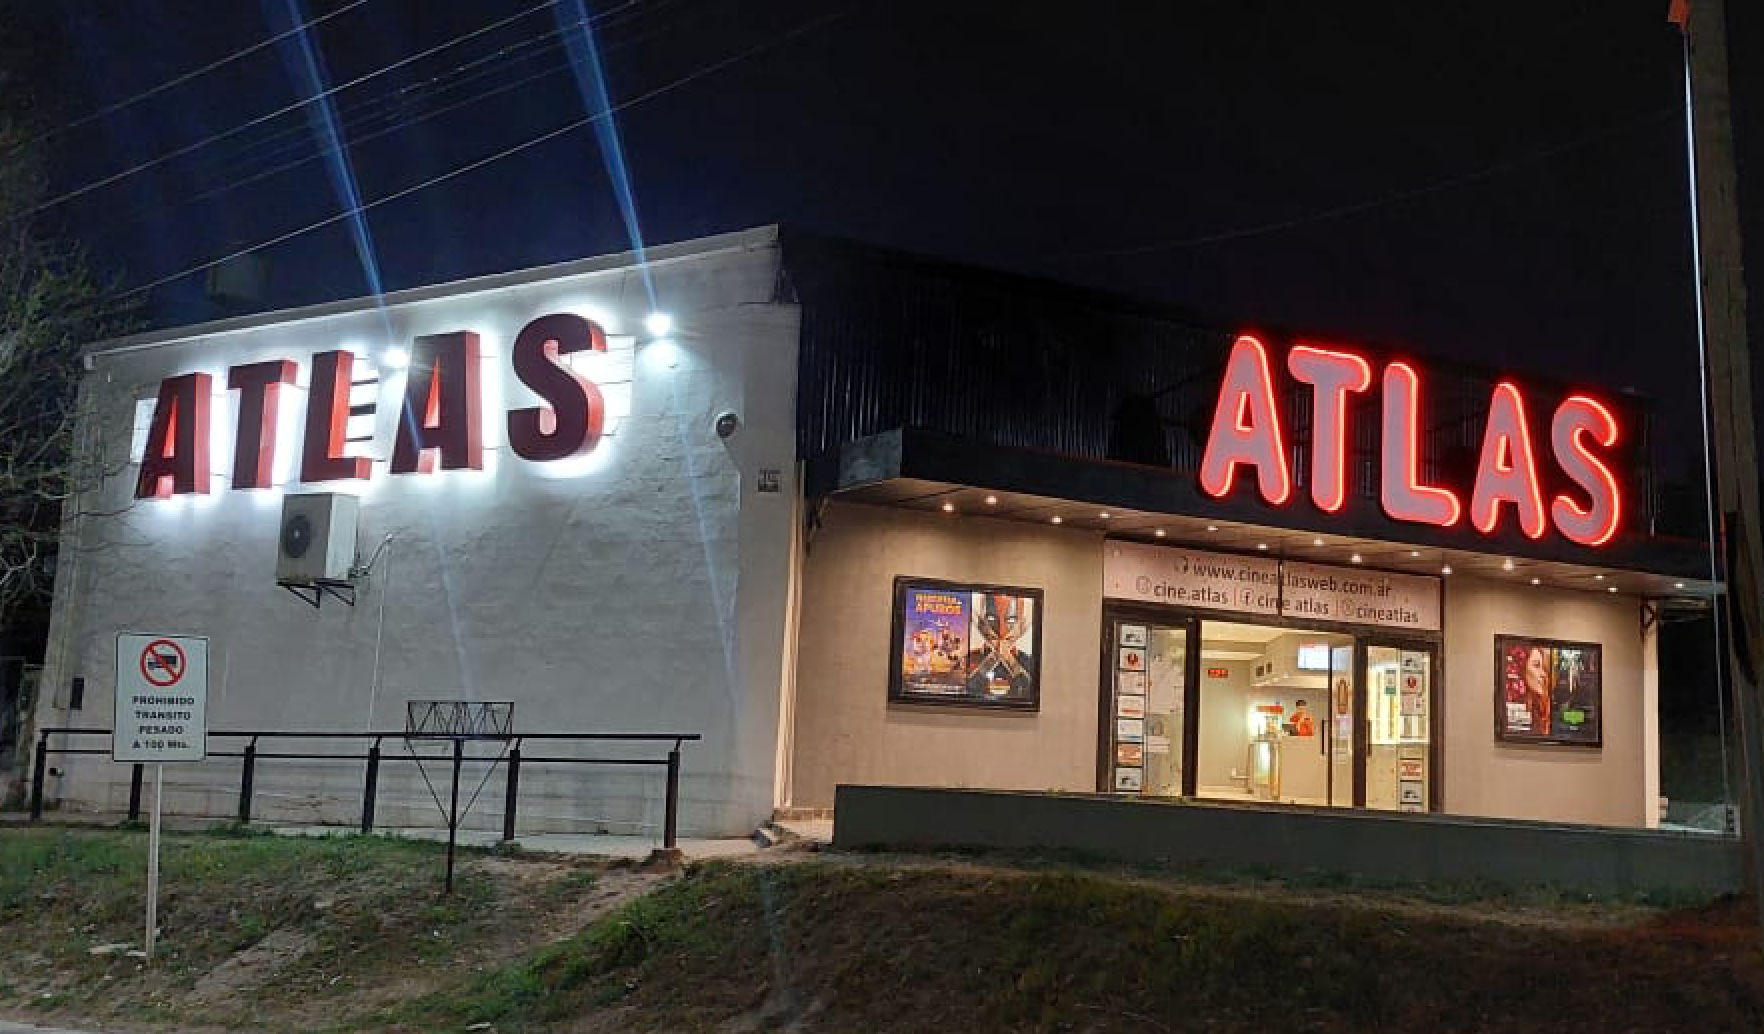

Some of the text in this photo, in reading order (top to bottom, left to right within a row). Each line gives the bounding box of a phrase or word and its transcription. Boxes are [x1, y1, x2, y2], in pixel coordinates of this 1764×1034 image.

[136, 313, 608, 499] ATLAS
[1200, 335, 1619, 546] ATLAS
[1153, 582, 1229, 605] cine.atlas
[1295, 597, 1329, 615] atlas
[1357, 603, 1419, 623] cineatlas
[131, 695, 194, 705] PROHIBIDO
[134, 711, 191, 720] TRANSITO
[139, 725, 184, 735] PESADO
[132, 740, 141, 749] A
[145, 740, 165, 750] 100
